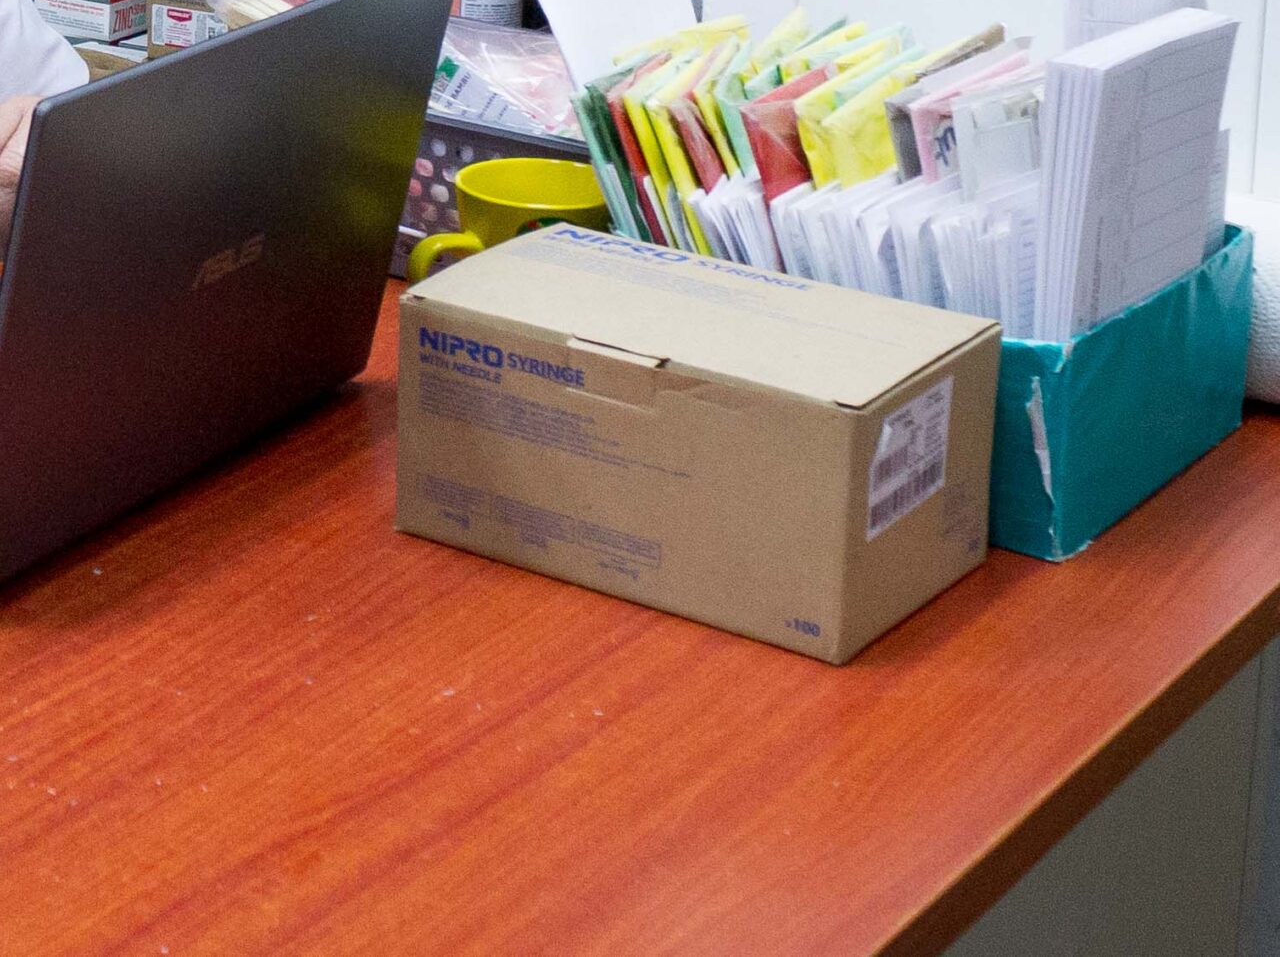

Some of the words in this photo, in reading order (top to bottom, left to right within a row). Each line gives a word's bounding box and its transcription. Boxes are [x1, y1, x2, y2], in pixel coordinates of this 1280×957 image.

[551, 228, 689, 263] NIPRO
[697, 260, 816, 292] SYRINGE
[419, 326, 505, 368] NIPRO
[506, 353, 586, 387] SYRINGE
[420, 353, 451, 371] WITH
[452, 362, 503, 384] NEEDLE
